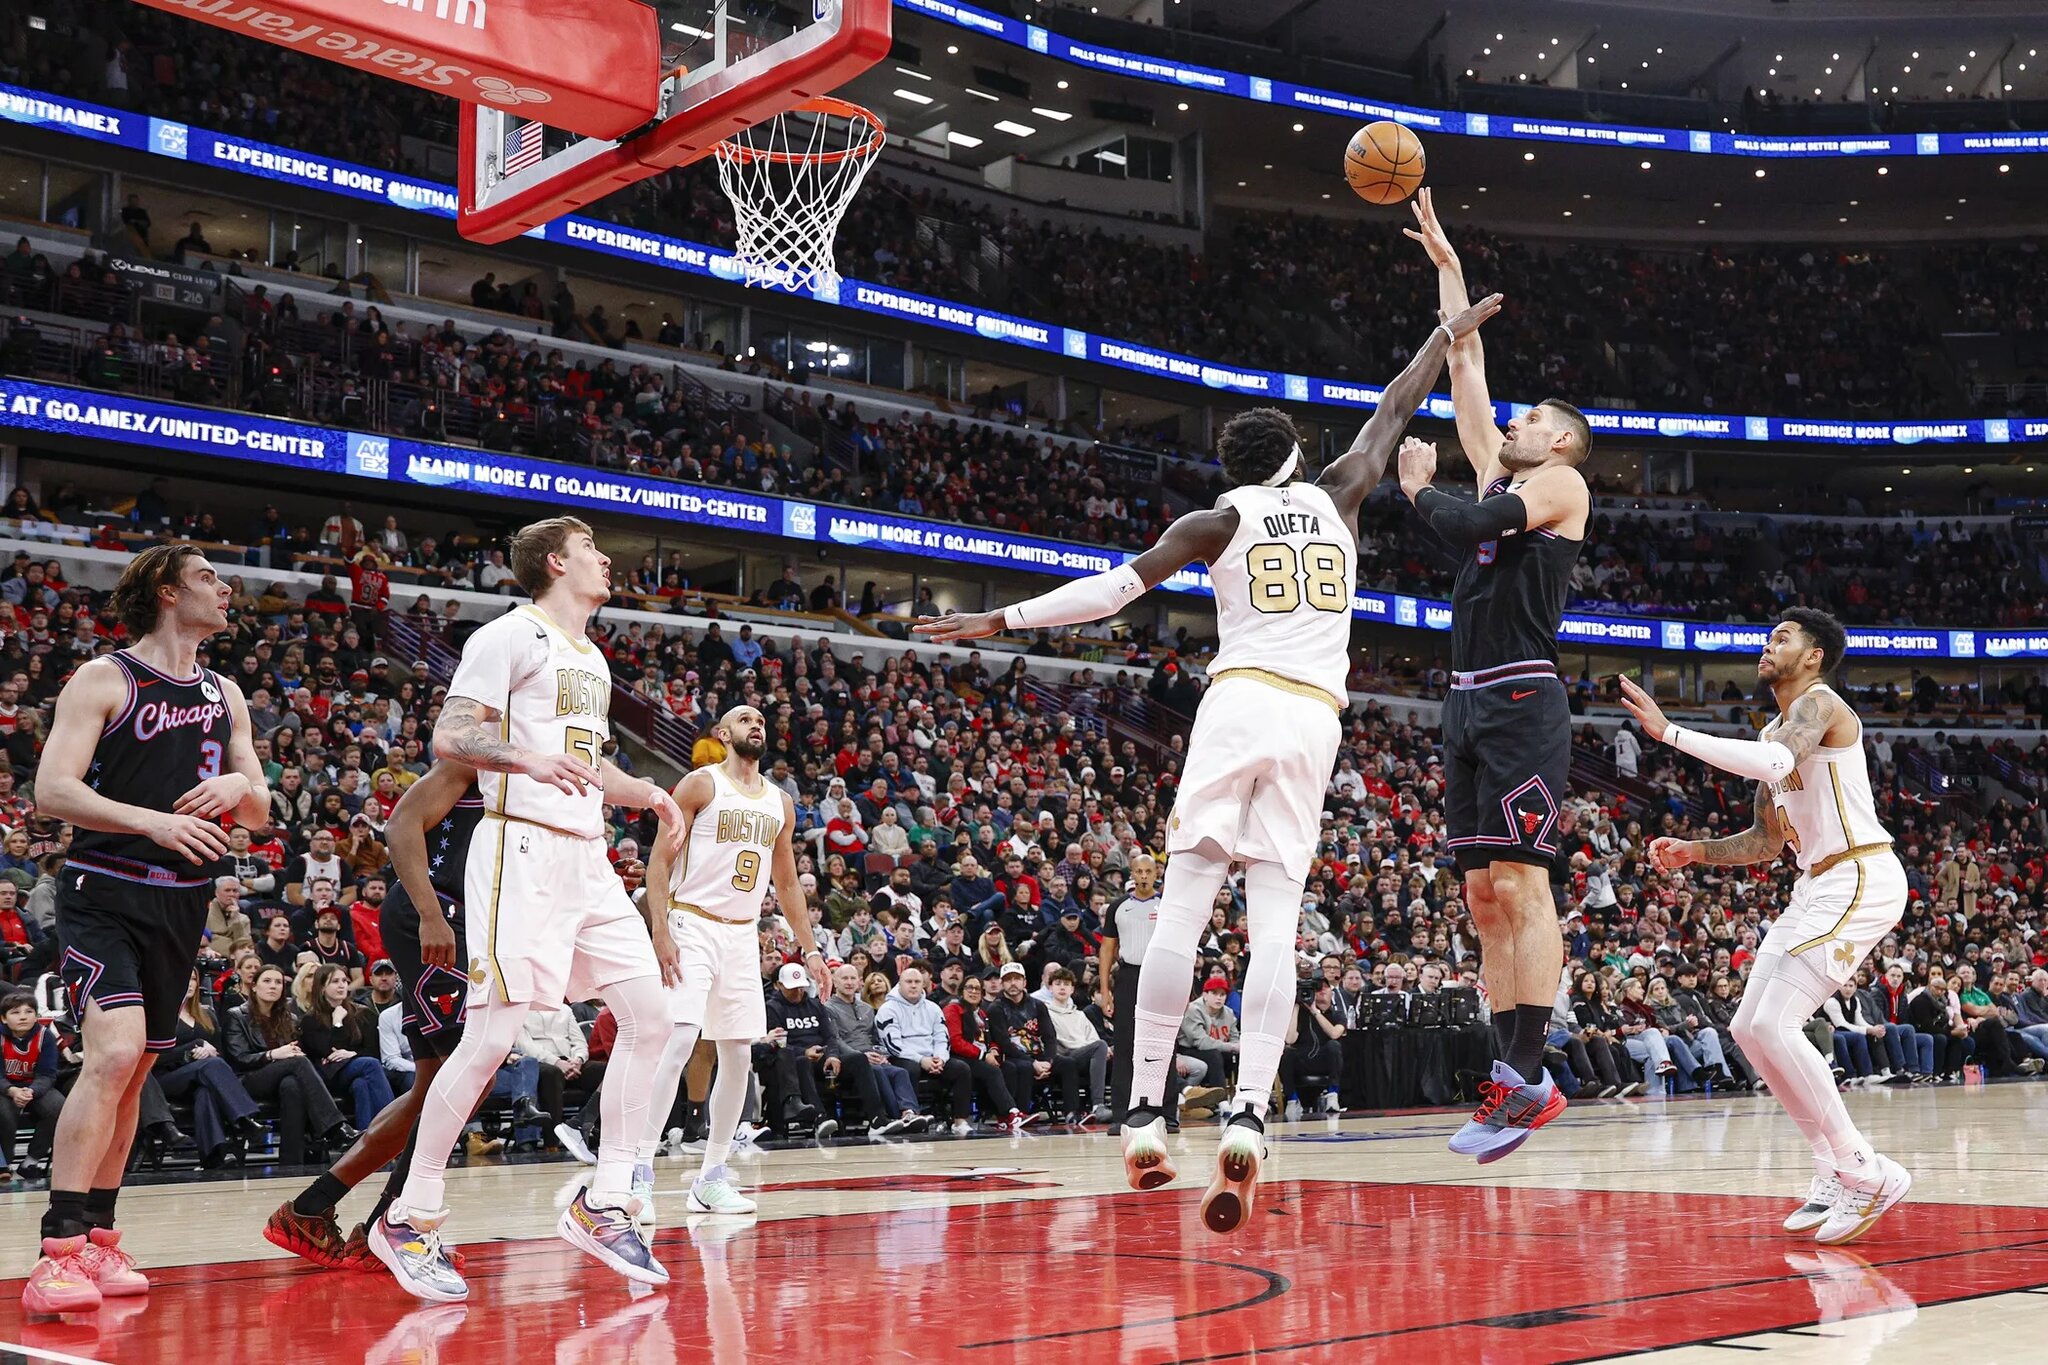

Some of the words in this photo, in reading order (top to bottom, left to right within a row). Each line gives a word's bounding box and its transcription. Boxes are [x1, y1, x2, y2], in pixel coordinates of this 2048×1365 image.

[1069, 46, 1096, 61] BULLS
[1095, 53, 1125, 68] GAMES
[1125, 59, 1143, 71] ARE
[1143, 63, 1176, 77] BETTER
[1294, 91, 1321, 105] BULLS
[1320, 96, 1349, 110] GAMES
[1348, 102, 1364, 113] ARE
[1364, 104, 1394, 117] BETTER
[1513, 123, 1540, 134] BULLS
[1539, 125, 1569, 136] GAMES
[1569, 127, 1586, 138] ARE
[1586, 129, 1617, 140] BETTER
[1964, 138, 1992, 148] BULLS
[1992, 137, 2022, 147] GAMES
[2022, 137, 2039, 147] ARE
[1734, 140, 1760, 151] BULLS
[1760, 142, 1790, 152] GAMES
[1789, 142, 1807, 151] ARE
[1807, 141, 1839, 151] BETTER
[214, 141, 328, 182] EXPERIENCE
[333, 168, 384, 194] MORE
[567, 221, 661, 257] EXPERIENCE
[664, 243, 706, 267] MORE
[127, 264, 171, 279] LEXUS
[857, 287, 936, 318] EXPERIENCE
[938, 306, 974, 327] MORE
[1100, 343, 1168, 370] EXPERIENCE
[1169, 358, 1200, 378] MORE
[11, 395, 42, 416] AT
[45, 399, 325, 458] GO.AMEX/UNITED-CENTER
[1622, 416, 1656, 430] MORE
[1783, 423, 1853, 439] EXPERIENCE
[1855, 426, 1890, 439] MORE
[356, 440, 389, 459] AM
[361, 455, 389, 473] EX
[407, 454, 470, 483] LEARN
[474, 464, 526, 488] MORE
[529, 473, 551, 491] AT
[554, 476, 767, 523] GO.AMEX/UNITED-CENTER
[791, 507, 816, 523] AM
[1263, 513, 1321, 538] QUETA
[796, 519, 816, 534] EX
[830, 517, 879, 543] LEARN
[881, 525, 922, 546] MORE
[923, 531, 942, 548] AT
[943, 534, 1112, 573] GO.AMEX/UNITED-CENTER
[1246, 542, 1348, 614] 88
[1694, 630, 1731, 649] LEARN
[1733, 632, 1769, 650] MORE
[1985, 638, 2026, 656] LEARN
[133, 700, 225, 742] Chicago
[197, 738, 224, 782] 3
[149, 871, 177, 882] BULLS
[731, 849, 761, 893] 9
[785, 1015, 820, 1030] BOSS
